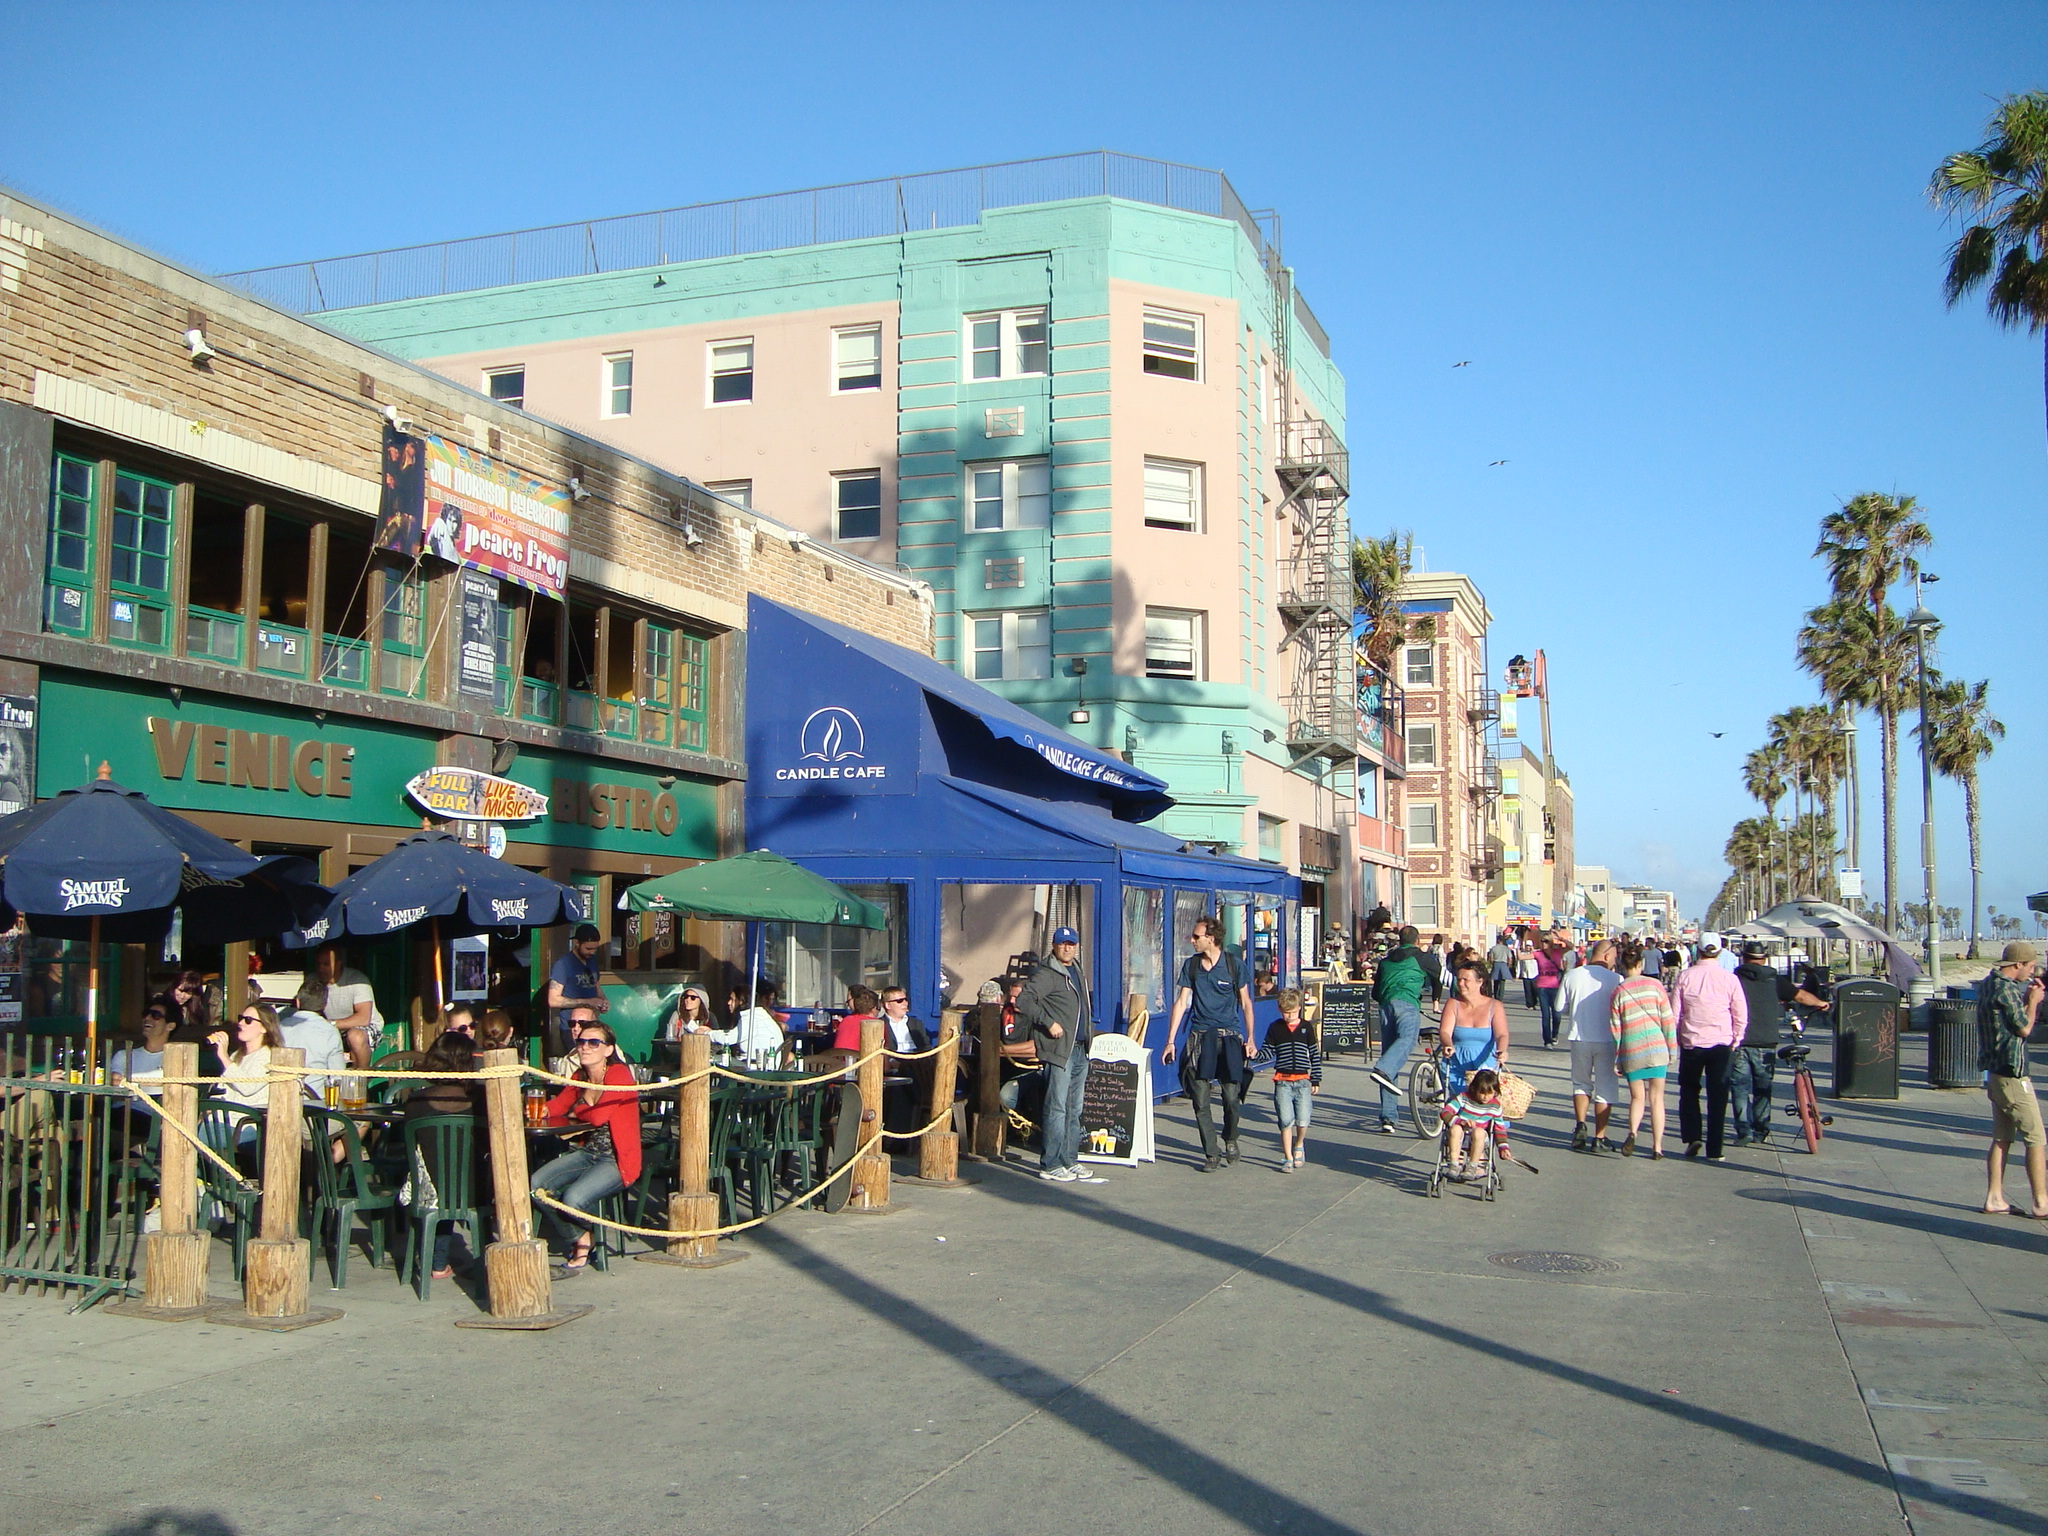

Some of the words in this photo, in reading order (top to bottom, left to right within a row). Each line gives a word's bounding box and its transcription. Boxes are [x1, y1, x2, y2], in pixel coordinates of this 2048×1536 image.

[459, 456, 493, 479] EVERY
[498, 472, 538, 495] SUNDAY
[430, 458, 451, 489] JIM
[453, 466, 507, 511] MORRISON
[510, 490, 570, 536] CELEBRATION
[464, 522, 524, 562] peace
[526, 539, 568, 590] frog
[3, 701, 34, 728] frog
[149, 717, 354, 799] VENICE
[1038, 743, 1074, 771] CANDLE
[1071, 756, 1097, 777] CAFE
[1092, 763, 1107, 779] &
[1102, 769, 1129, 786] GRILL
[775, 767, 840, 780] CANDLE
[843, 765, 886, 778] CAFE
[429, 773, 467, 794] FULL
[485, 779, 517, 800] LIVE
[430, 793, 469, 813] BAR
[482, 799, 528, 819] MUSIC
[553, 778, 679, 836] BISTRO
[60, 877, 130, 897] SAMUEL
[63, 892, 124, 911] ADAMS
[383, 904, 428, 922] SAMUEL
[491, 897, 529, 911] SAMUEL
[496, 907, 526, 921] ADAMS
[1094, 1045, 1128, 1053] BELGIUM
[1089, 1061, 1106, 1070] Food
[1108, 1062, 1129, 1071] Menu
